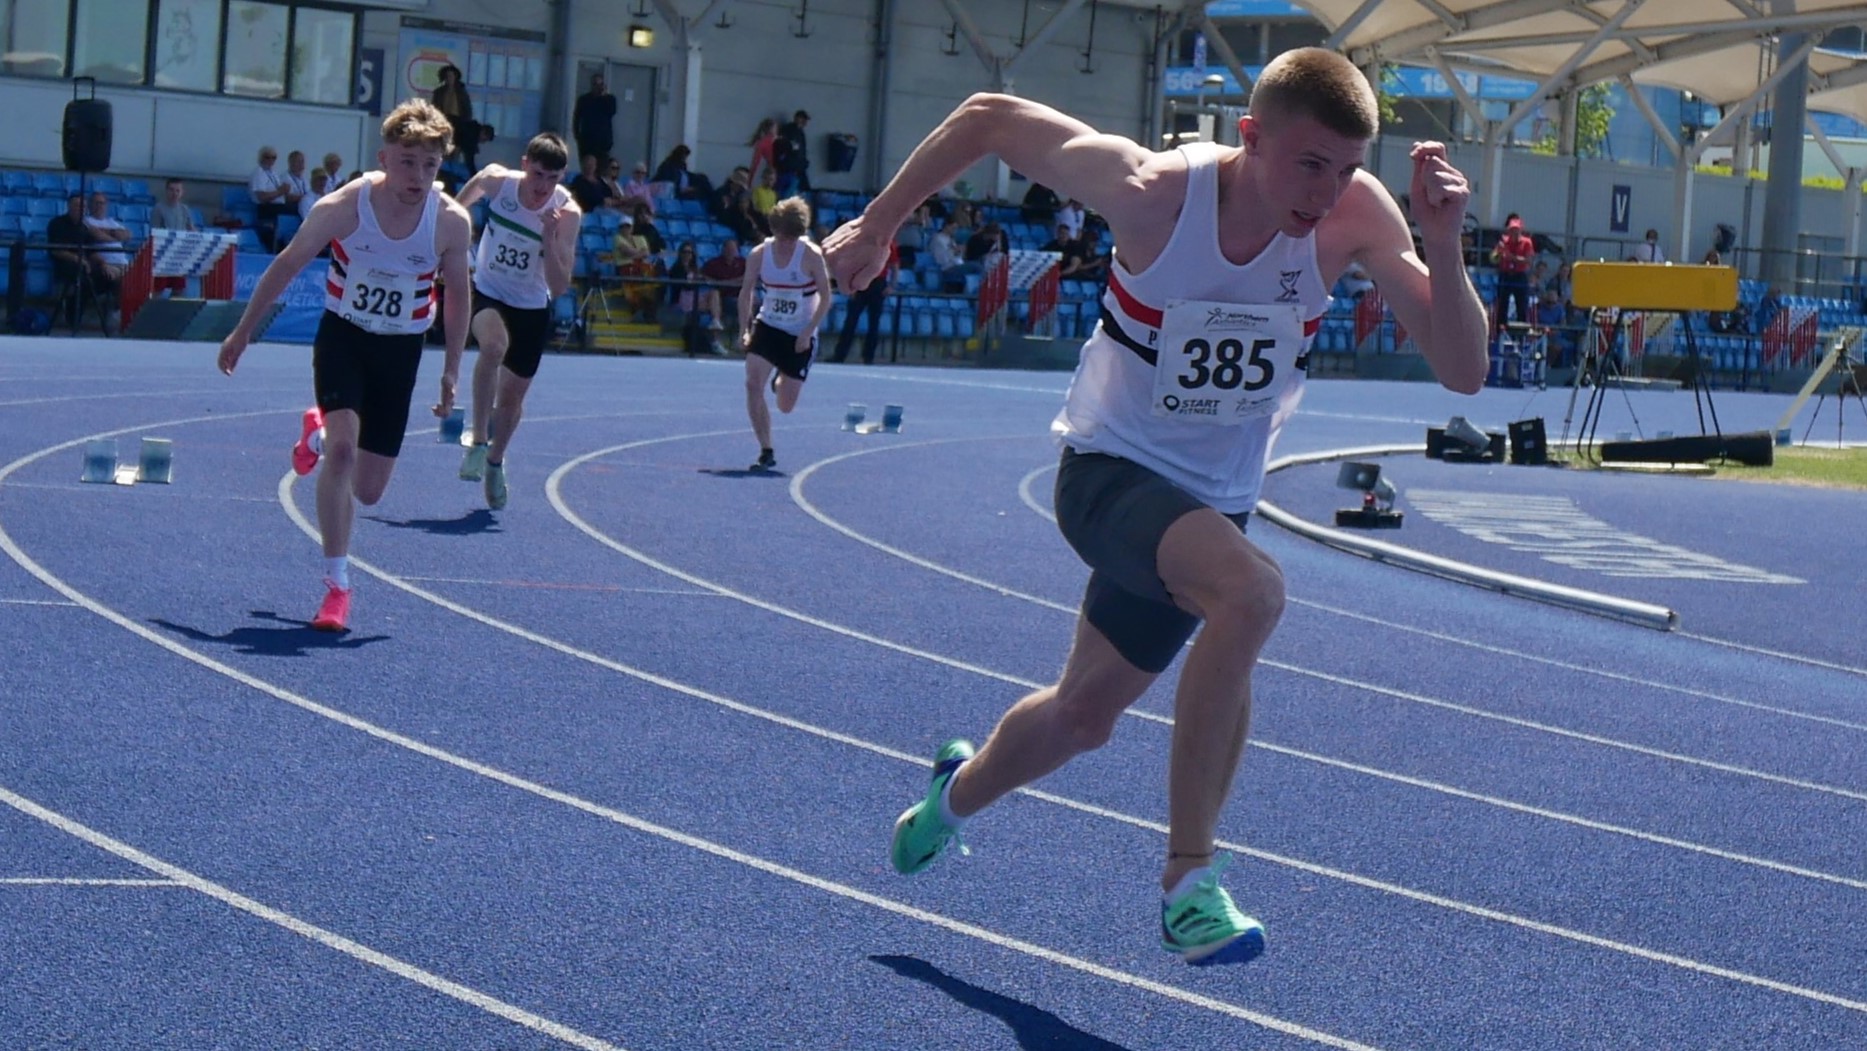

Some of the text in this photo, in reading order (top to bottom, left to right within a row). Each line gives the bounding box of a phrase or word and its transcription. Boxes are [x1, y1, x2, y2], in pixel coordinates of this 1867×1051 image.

[359, 59, 374, 104] S
[1616, 193, 1628, 223] V
[495, 243, 530, 271] 333
[352, 283, 403, 318] 328
[772, 298, 797, 315] 389
[1178, 338, 1276, 391] 385
[1179, 407, 1217, 416] FITNESS
[1181, 399, 1221, 409] START
